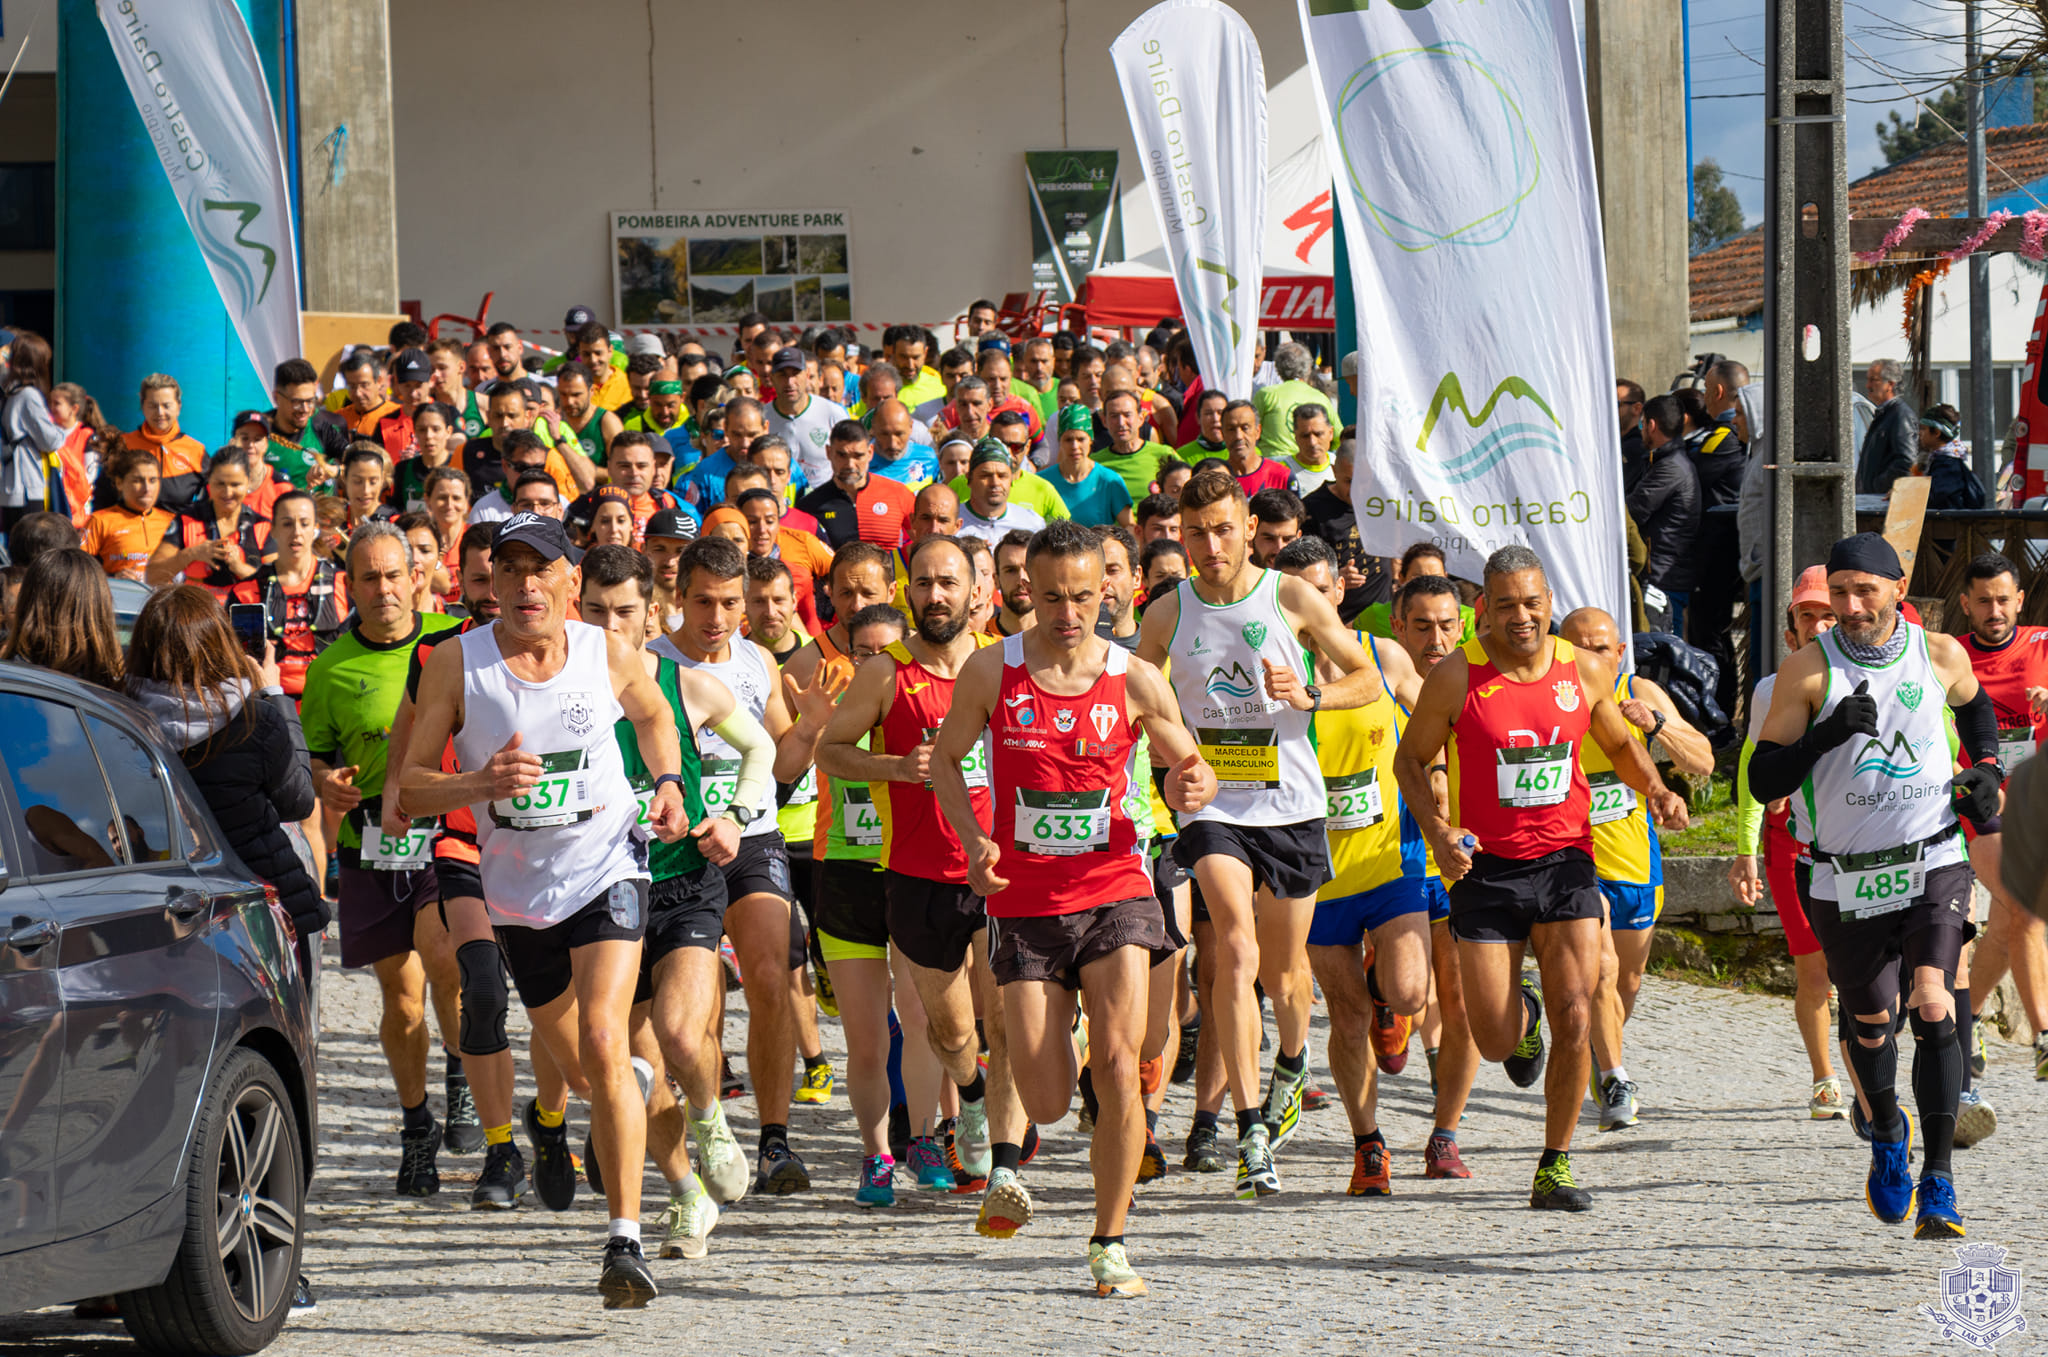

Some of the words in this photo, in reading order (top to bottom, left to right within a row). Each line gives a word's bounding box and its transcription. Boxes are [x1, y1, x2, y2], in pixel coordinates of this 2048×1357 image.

[617, 215, 701, 228] POMBEIRA
[704, 213, 800, 228] ADVENTURE
[803, 212, 844, 227] PARK
[505, 511, 540, 528] NIKE
[1202, 705, 1241, 719] Castro
[1244, 701, 1276, 714] Daire
[1214, 747, 1259, 757] MARCELO
[1223, 759, 1275, 768] MASCULINO
[1515, 766, 1562, 792] 467
[512, 778, 570, 811] 637
[1327, 791, 1369, 817] 623
[1845, 790, 1896, 806] Castro
[1902, 782, 1941, 800] Daire
[1033, 814, 1092, 840] 633
[379, 833, 426, 857] 587
[1855, 869, 1910, 901] 485
